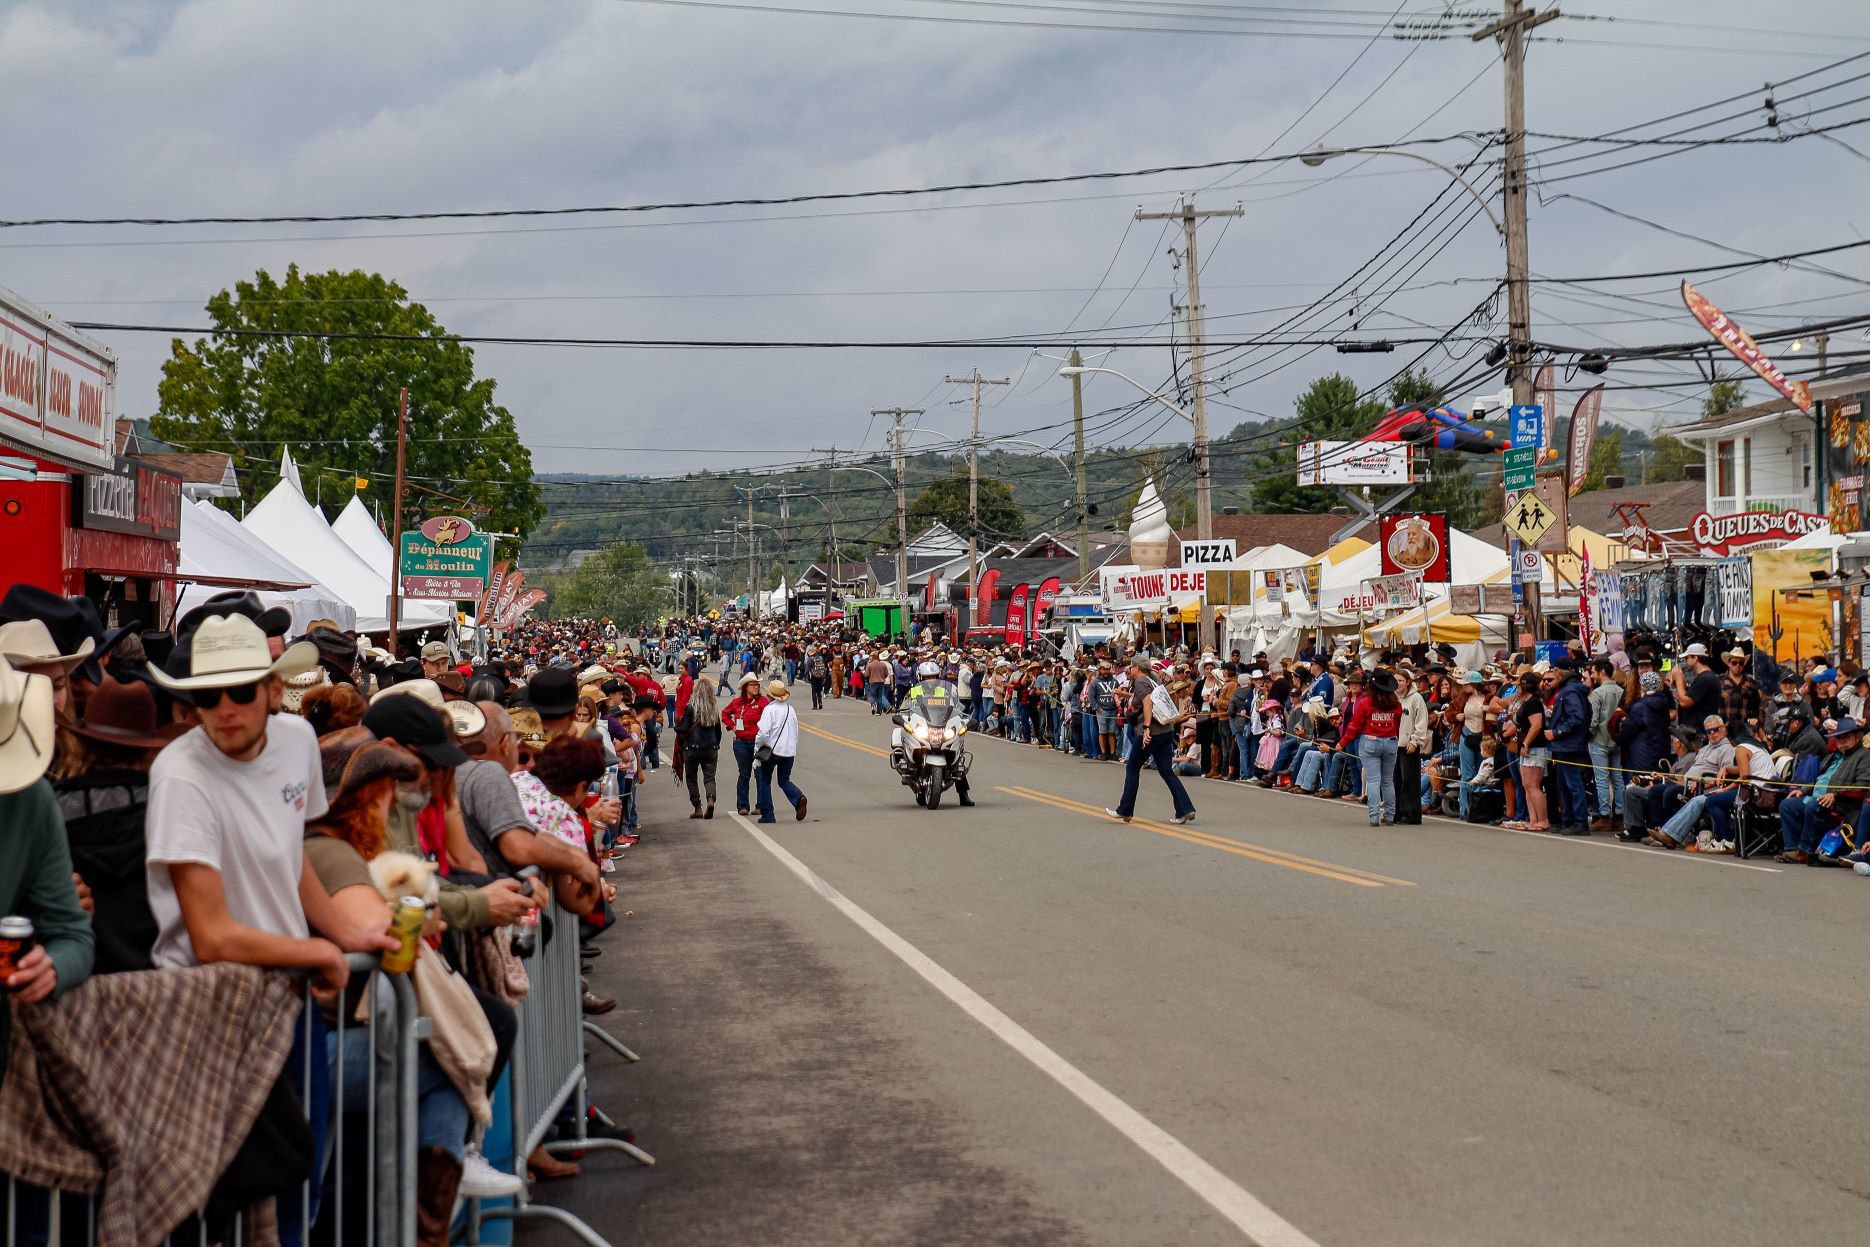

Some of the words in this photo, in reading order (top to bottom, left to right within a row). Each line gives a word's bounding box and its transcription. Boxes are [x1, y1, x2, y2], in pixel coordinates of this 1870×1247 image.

[49, 366, 72, 418] SLUSH
[1573, 416, 1587, 478] NACHOS
[1693, 513, 1770, 546] QUEUES
[1783, 511, 1830, 534] CAST
[408, 542, 483, 561] Dépanneur
[426, 559, 475, 571] Moulin
[1184, 544, 1234, 564] PIZZA
[1130, 574, 1165, 600] TOUNE
[1596, 567, 1620, 594] JEAN
[1720, 560, 1750, 589] JEANS
[507, 592, 534, 620] ARIAT
[1343, 594, 1374, 609] DÉJEU
[1600, 597, 1620, 626] FEMM
[1720, 590, 1750, 619] HOMME
